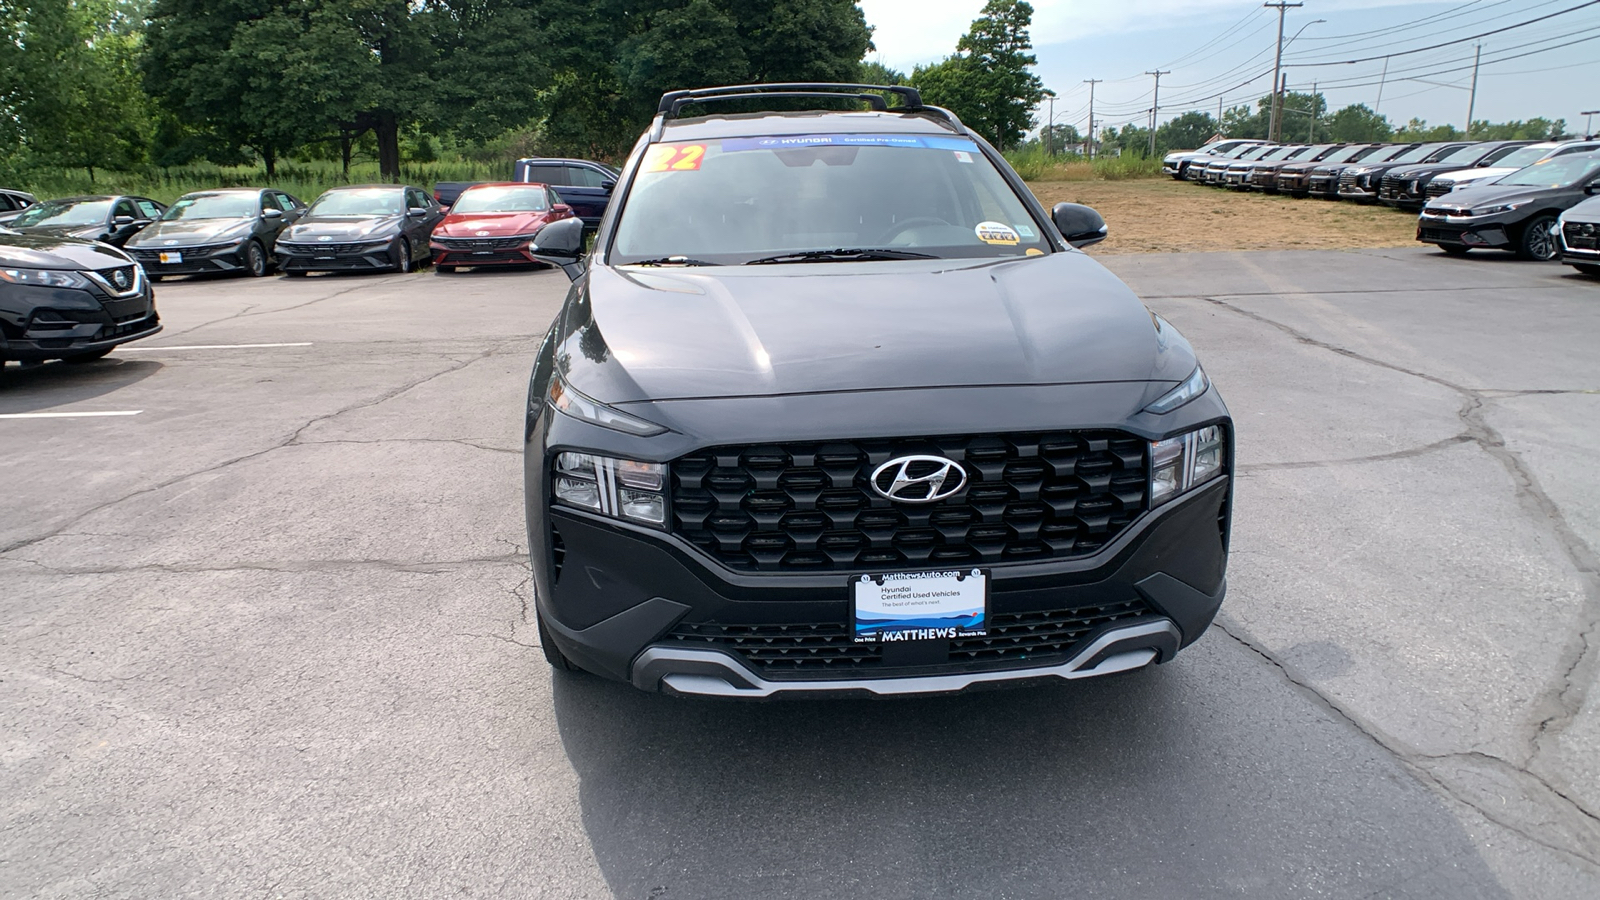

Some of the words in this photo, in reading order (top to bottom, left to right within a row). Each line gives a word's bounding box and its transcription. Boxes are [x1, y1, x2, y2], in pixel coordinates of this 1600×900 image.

[651, 145, 705, 170] 22
[882, 570, 961, 581] MatthewsAuto.com
[881, 586, 912, 594] Hyundai
[881, 627, 957, 642] MATTHEWS
